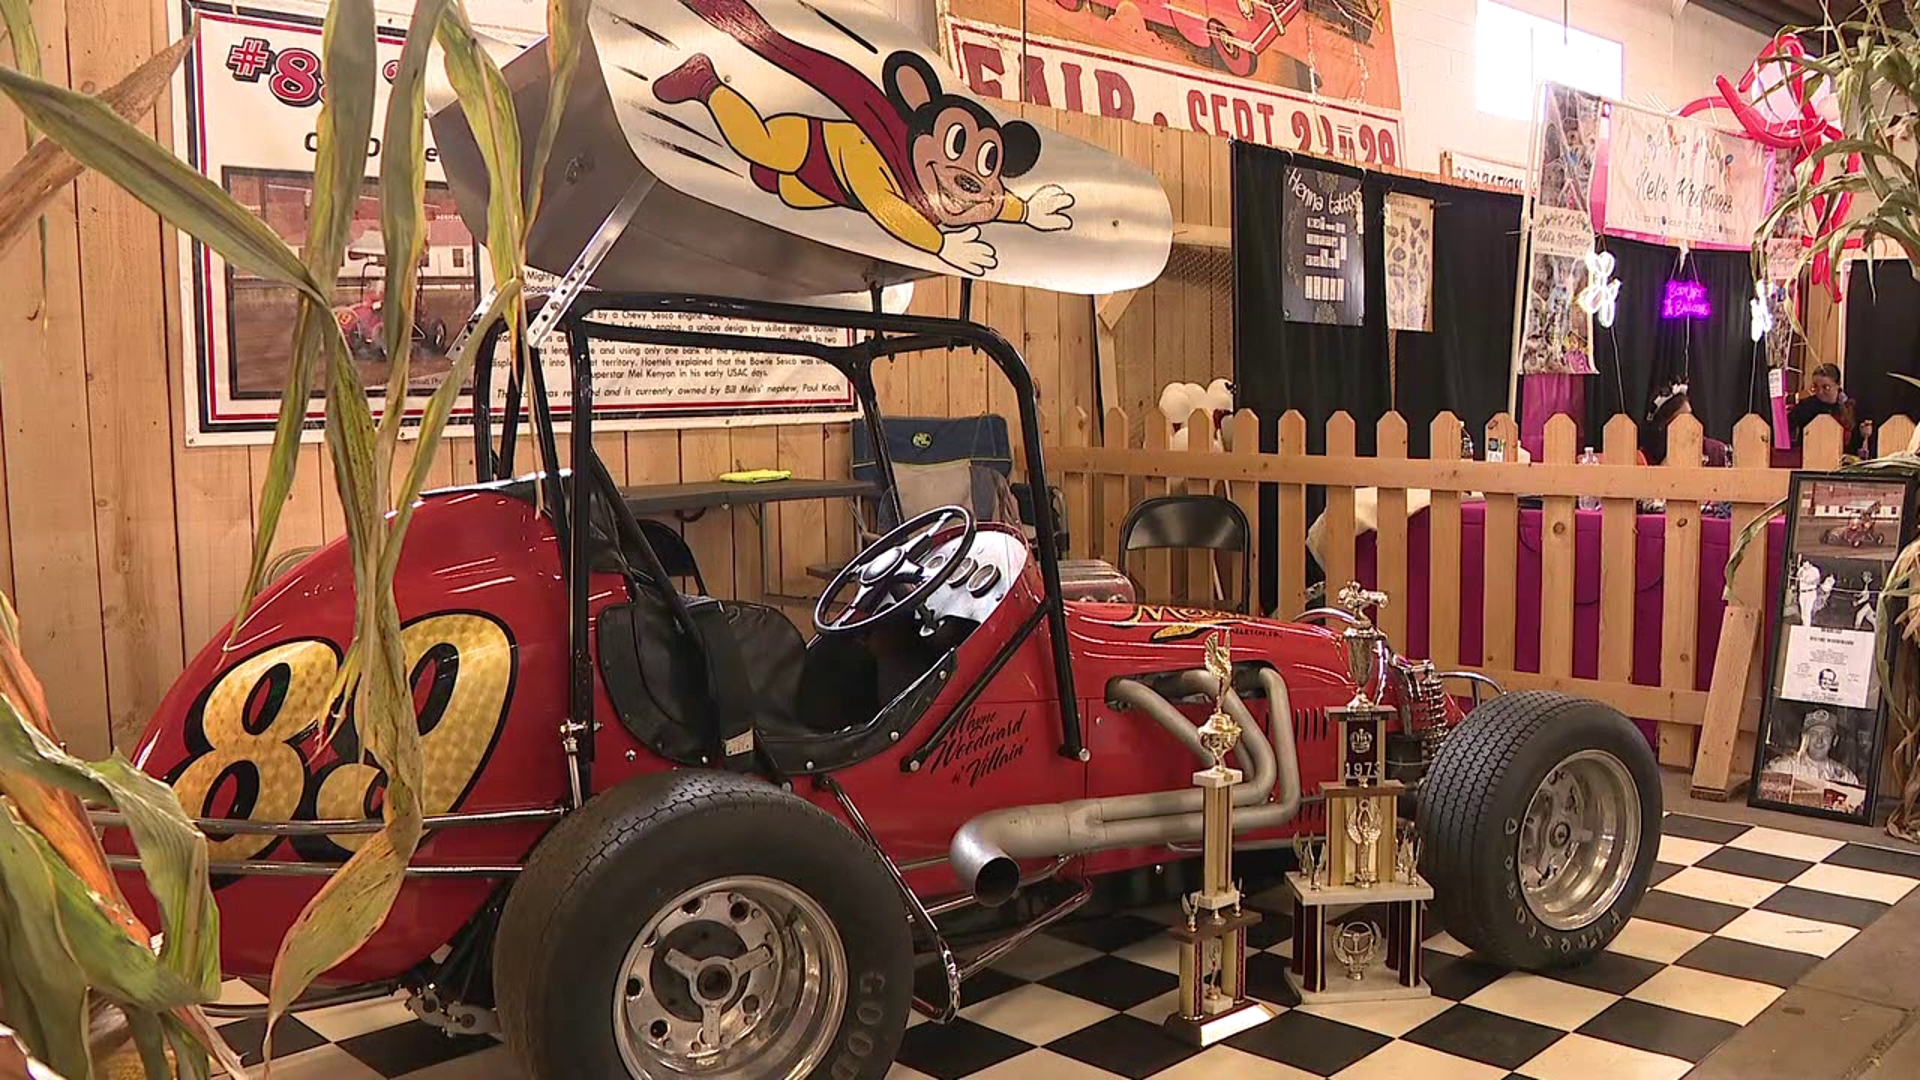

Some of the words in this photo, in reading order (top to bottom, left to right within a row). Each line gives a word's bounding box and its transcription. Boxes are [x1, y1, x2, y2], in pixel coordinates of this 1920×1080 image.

[1288, 167, 1324, 212] Henna
[526, 270, 555, 283] Mighty
[696, 321, 721, 333] unique
[724, 322, 747, 334] design
[751, 323, 761, 333] by
[765, 323, 787, 332] skilled
[788, 326, 810, 334] engine
[824, 335, 838, 344] two
[599, 345, 616, 355] and
[619, 345, 641, 357] using
[644, 345, 661, 356] only
[664, 347, 679, 355] one
[549, 357, 566, 367] into
[675, 356, 713, 367] explained
[716, 357, 731, 366] that
[734, 357, 746, 366] the
[628, 368, 643, 378] Mel
[646, 368, 676, 380] Kenyon
[679, 368, 688, 378] in
[689, 368, 701, 378] his
[704, 368, 724, 379] early
[727, 367, 748, 378] USAC
[603, 386, 622, 397] and
[624, 386, 631, 396] is
[635, 386, 673, 397] currently
[677, 385, 708, 396] owned
[709, 384, 721, 396] by
[724, 384, 738, 394] Bill
[766, 383, 799, 395] nephew,
[802, 383, 819, 393] Paul
[930, 708, 1027, 774] Woodward
[165, 608, 519, 888] 89
